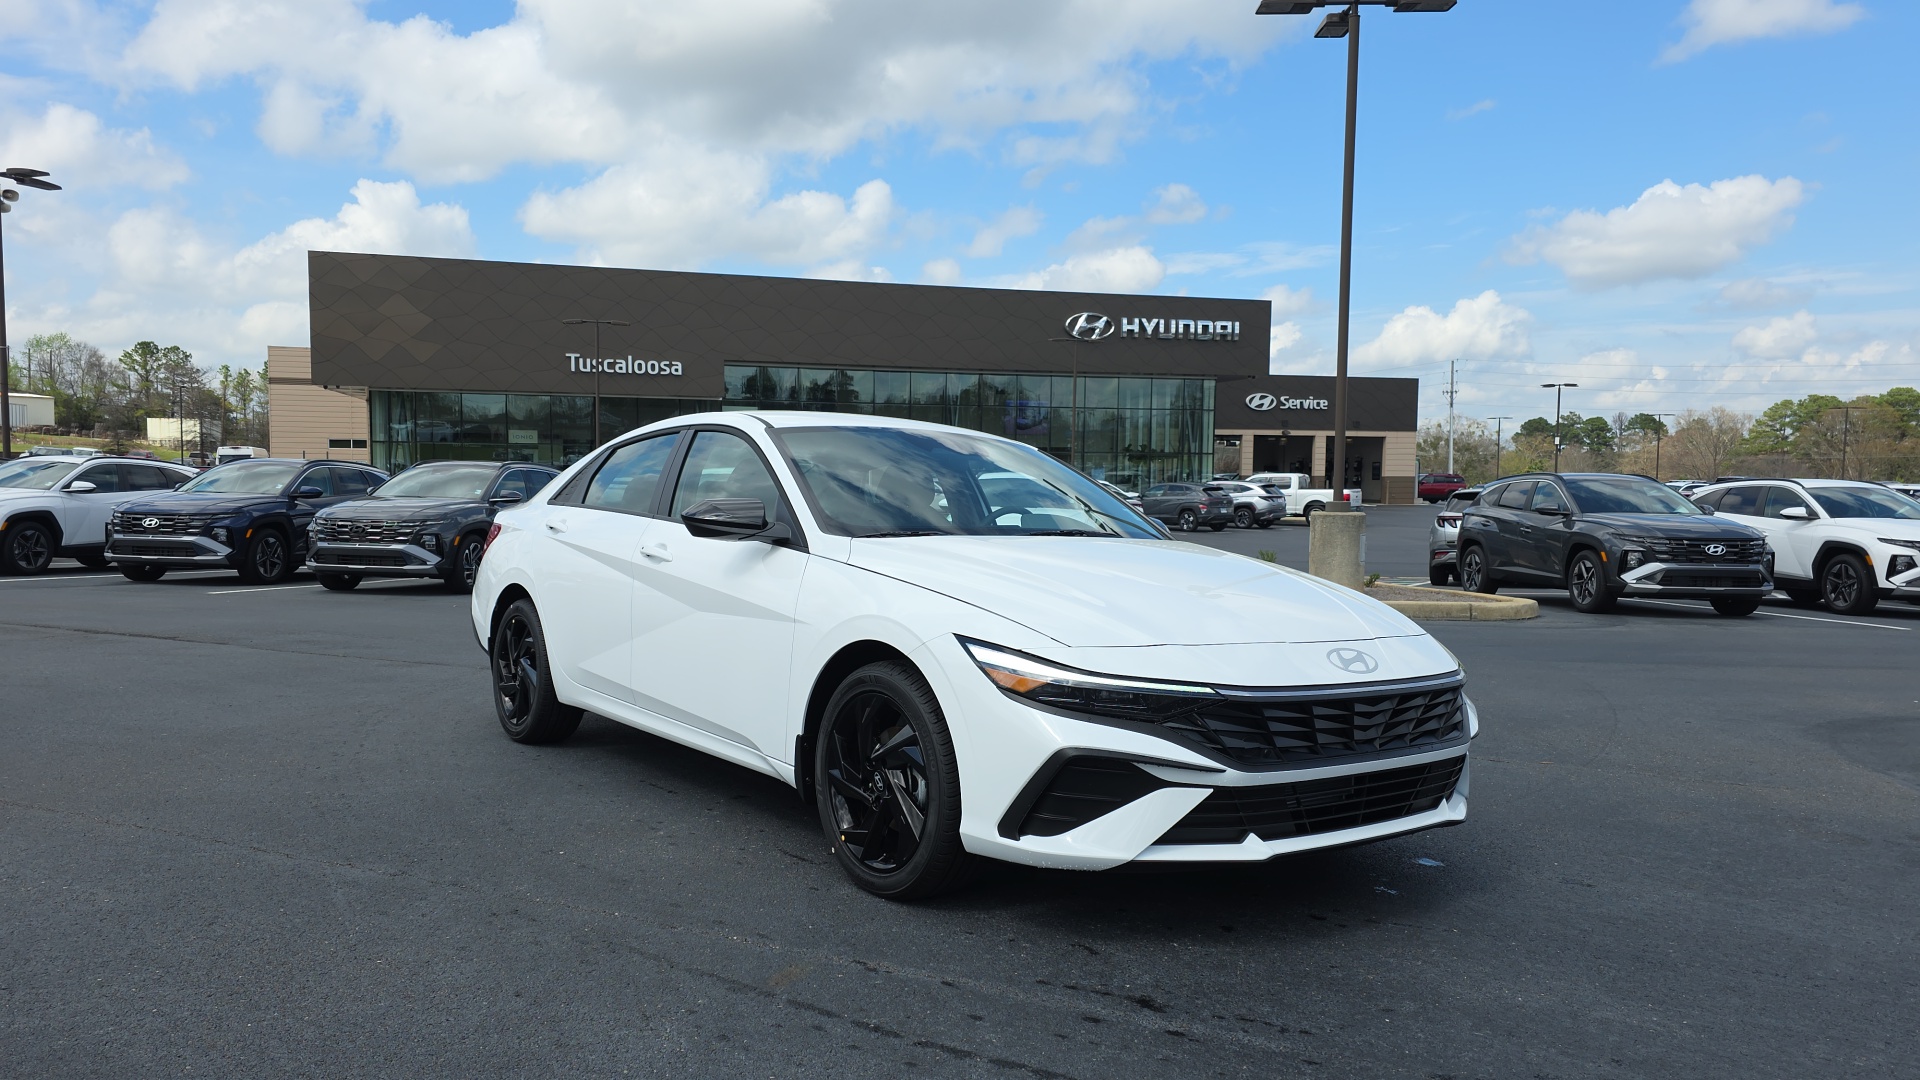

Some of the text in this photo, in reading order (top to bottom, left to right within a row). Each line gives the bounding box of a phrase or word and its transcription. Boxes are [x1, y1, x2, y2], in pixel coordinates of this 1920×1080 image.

[1120, 317, 1240, 340] HYUNDAI
[565, 353, 682, 375] Tuscaloosa
[1280, 396, 1328, 409] Service
